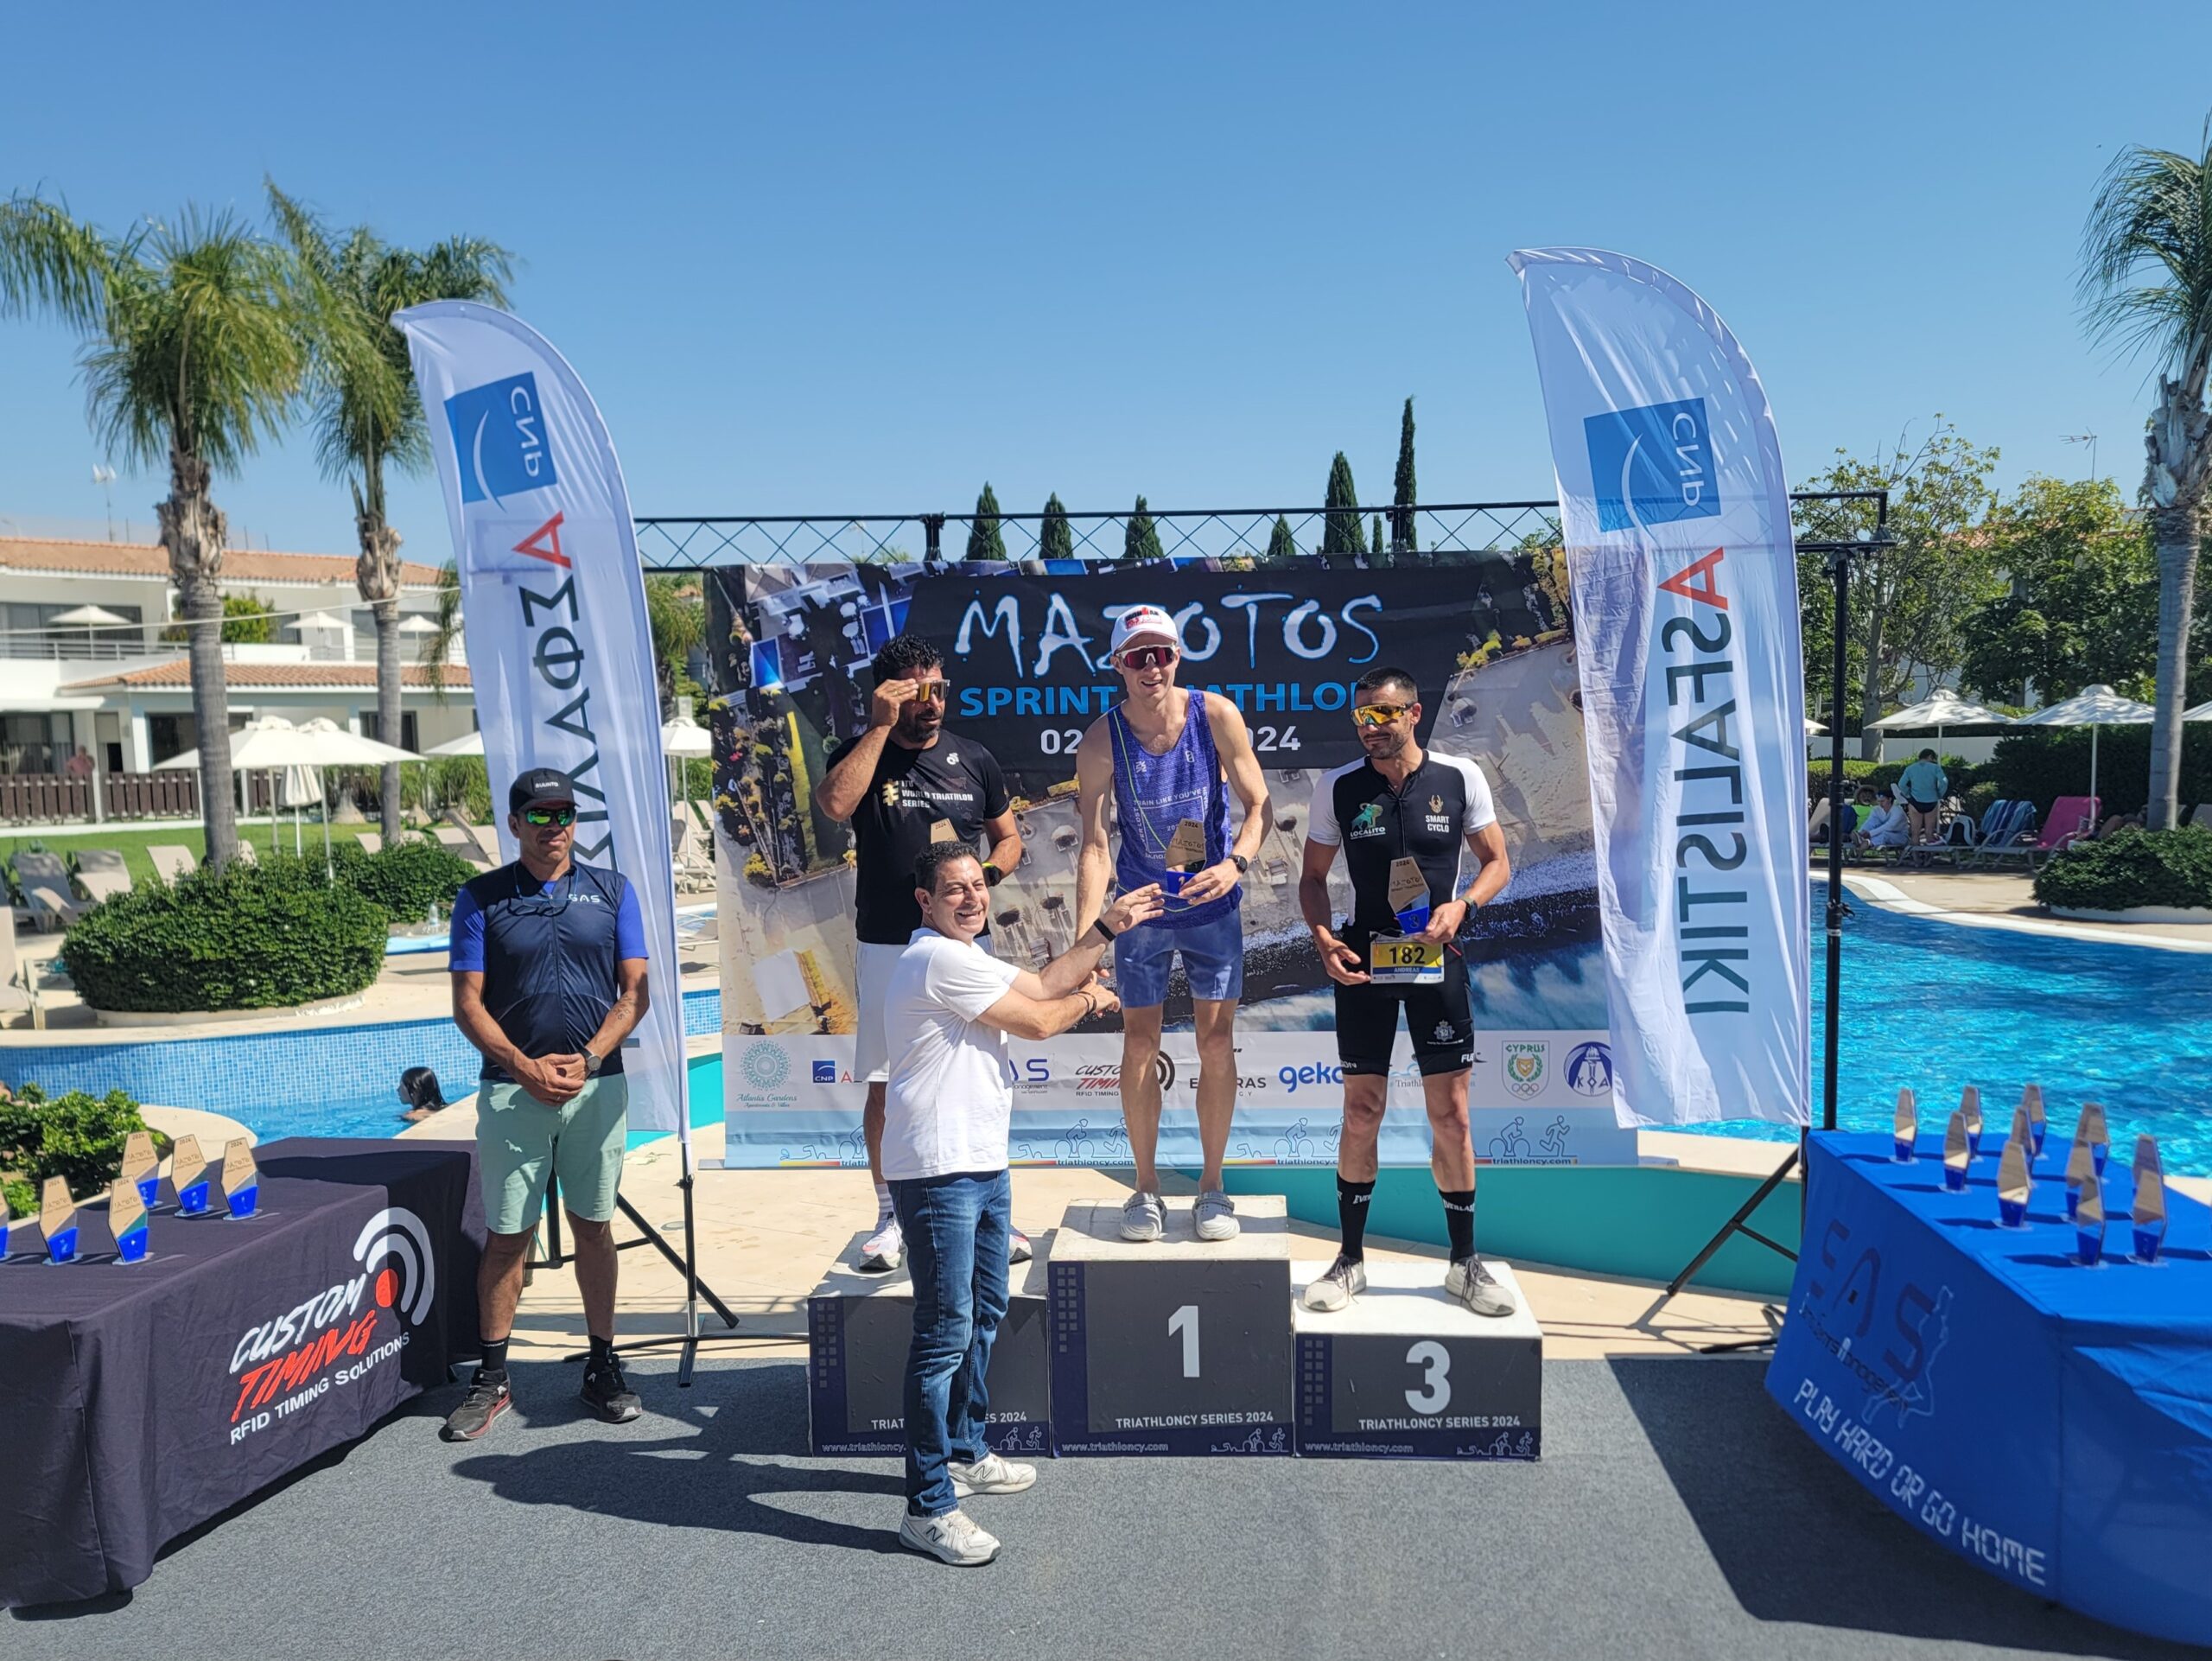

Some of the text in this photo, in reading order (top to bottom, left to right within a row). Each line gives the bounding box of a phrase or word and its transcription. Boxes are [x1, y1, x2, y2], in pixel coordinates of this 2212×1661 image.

[959, 686, 1118, 716] SPRINT
[1040, 725, 1301, 754] 02 24
[902, 799, 931, 808] SERIES
[931, 792, 973, 802] TRIATHLON
[1425, 815, 1450, 824] SMART
[1350, 826, 1386, 837] LOCALITO
[1427, 824, 1450, 833] CYCLO
[1389, 946, 1426, 964] 182
[1505, 1043, 1546, 1053] CYPRUS
[736, 1092, 798, 1102] Atlantis Gardens
[229, 1273, 367, 1374] CUSTOM
[1168, 1305, 1200, 1378] 1
[230, 1309, 378, 1423] TIMING
[1404, 1340, 1452, 1415] 3
[230, 1411, 270, 1446] RFID
[274, 1377, 330, 1419] TIMING
[1000, 1411, 1027, 1423] 2024
[1116, 1411, 1274, 1429] TRIATHLONCY SERIES 2024
[1358, 1415, 1521, 1430] TRIATHLONCY SERIES 2024
[1062, 1441, 1169, 1454] www.triathloncy.com
[1305, 1441, 1414, 1454] www.triathloncy.com
[1793, 1378, 2046, 1588] PLAY HARD OR GO HOME
